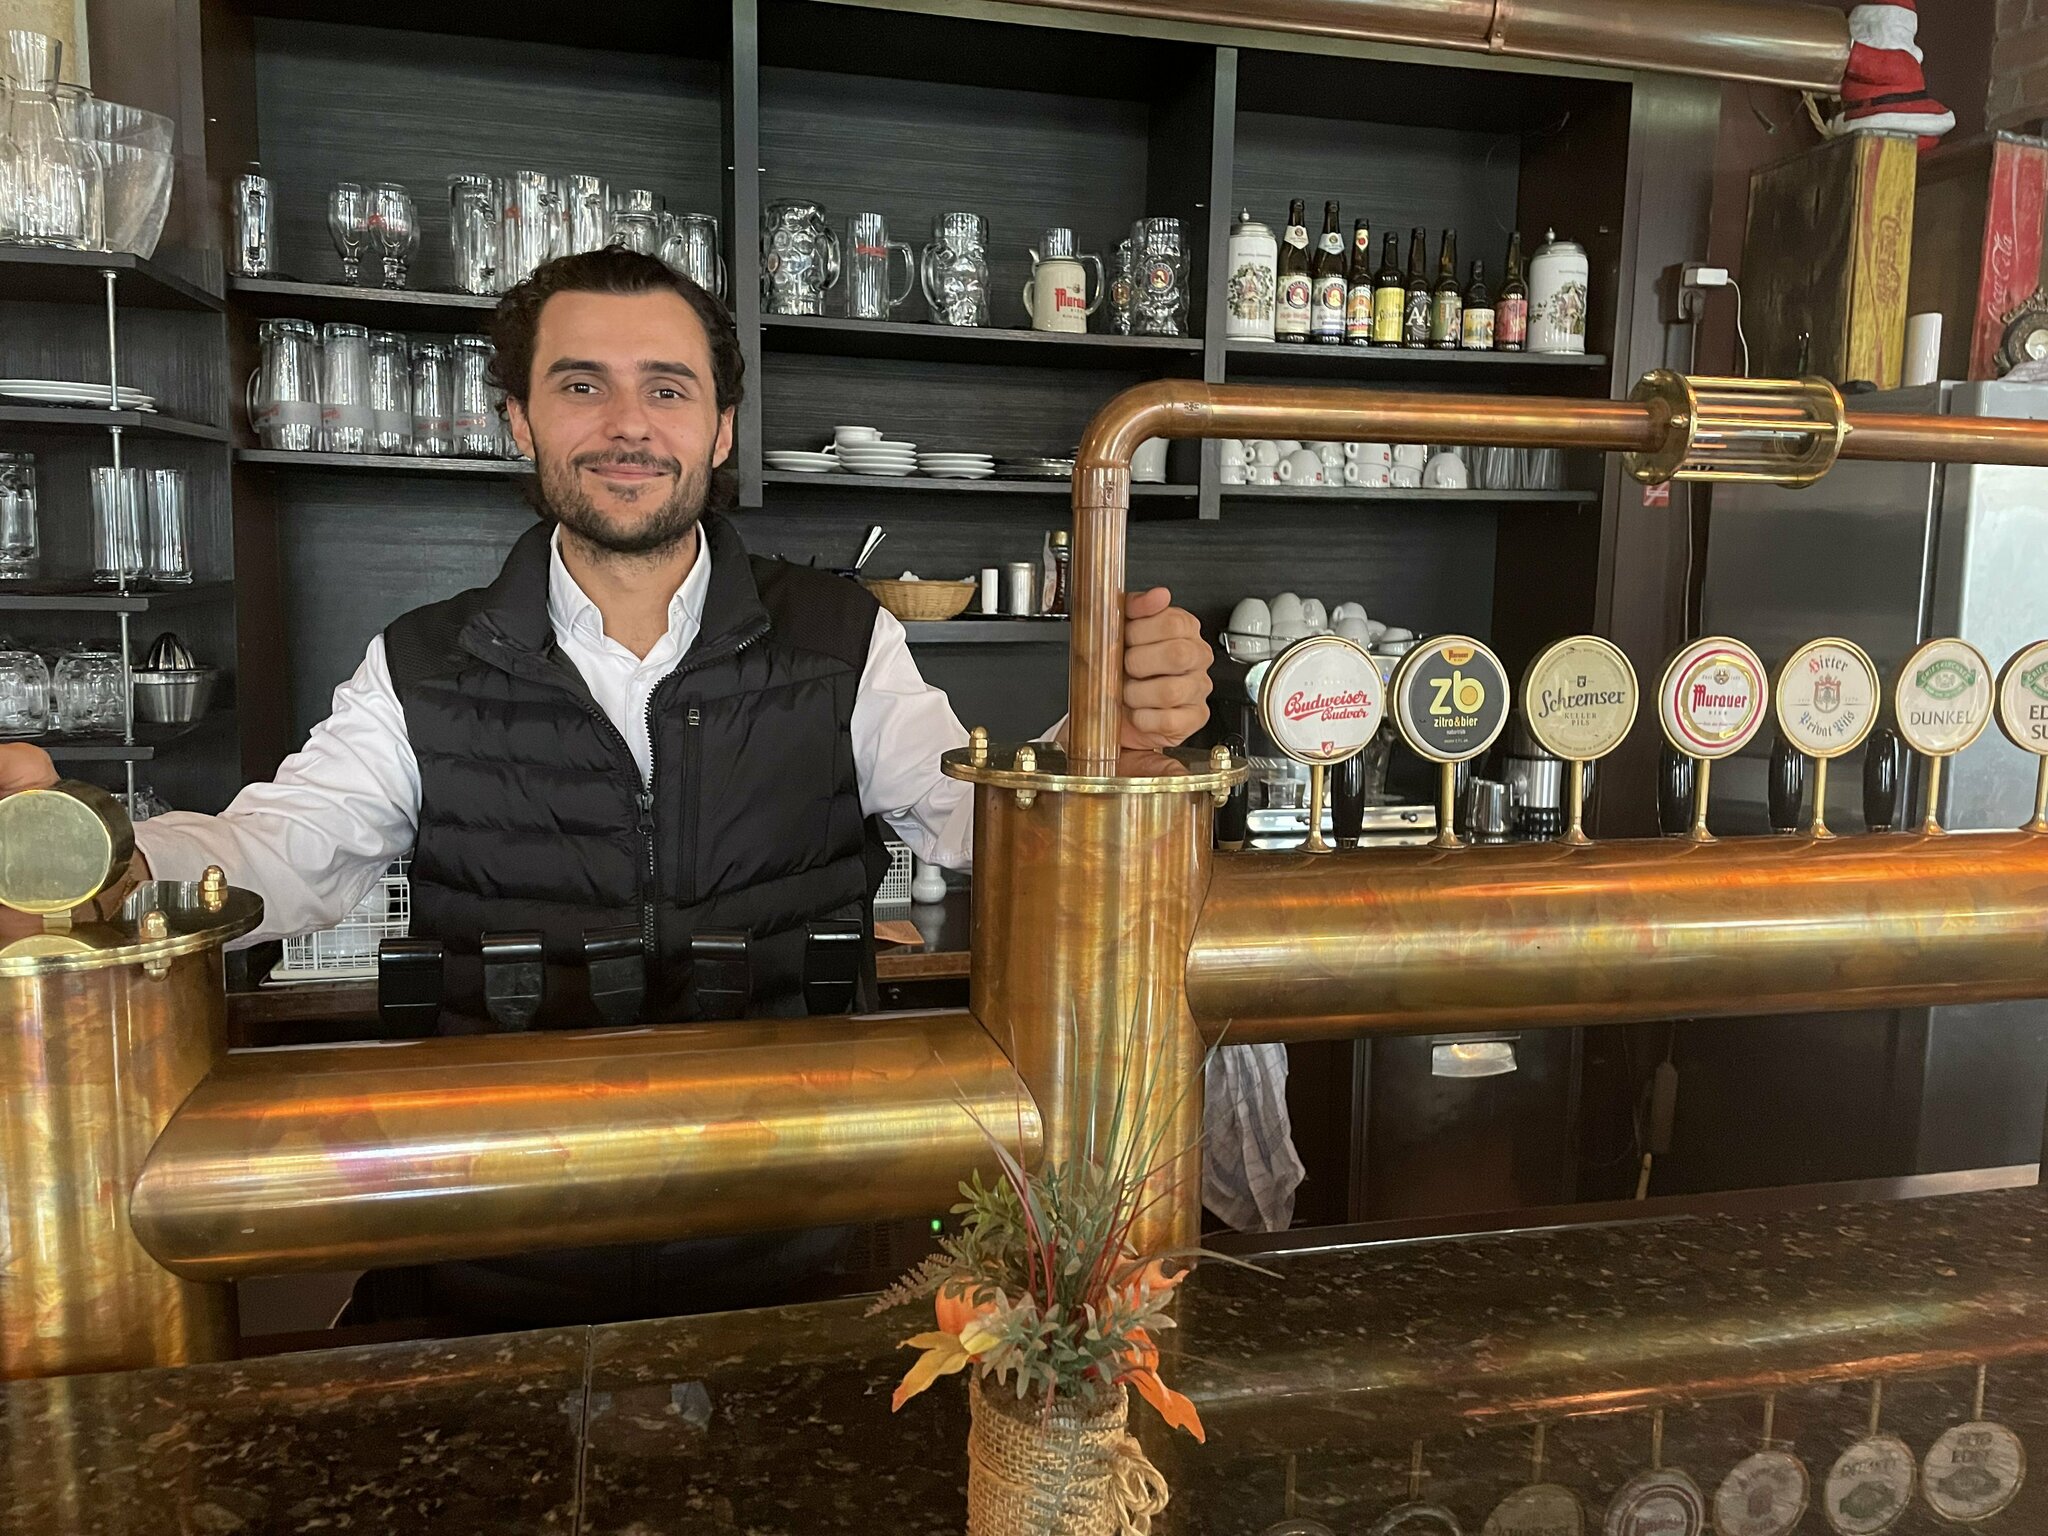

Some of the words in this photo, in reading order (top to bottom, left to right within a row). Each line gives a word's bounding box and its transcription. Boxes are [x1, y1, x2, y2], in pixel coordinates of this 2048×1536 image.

[1809, 655, 1848, 673] Hirter
[1430, 670, 1485, 714] zb
[1693, 684, 1747, 713] Murauer
[1284, 689, 1371, 718] Budweiser
[1538, 687, 1626, 719] Schremser
[1321, 706, 1369, 721] Budvar
[1433, 715, 1478, 728] zitro&bier
[1564, 711, 1597, 720] KELLER
[1910, 710, 1974, 725] DUNKEL
[1571, 719, 1591, 727] PILS
[1799, 710, 1832, 737] Privat
[1832, 711, 1856, 736] Pils
